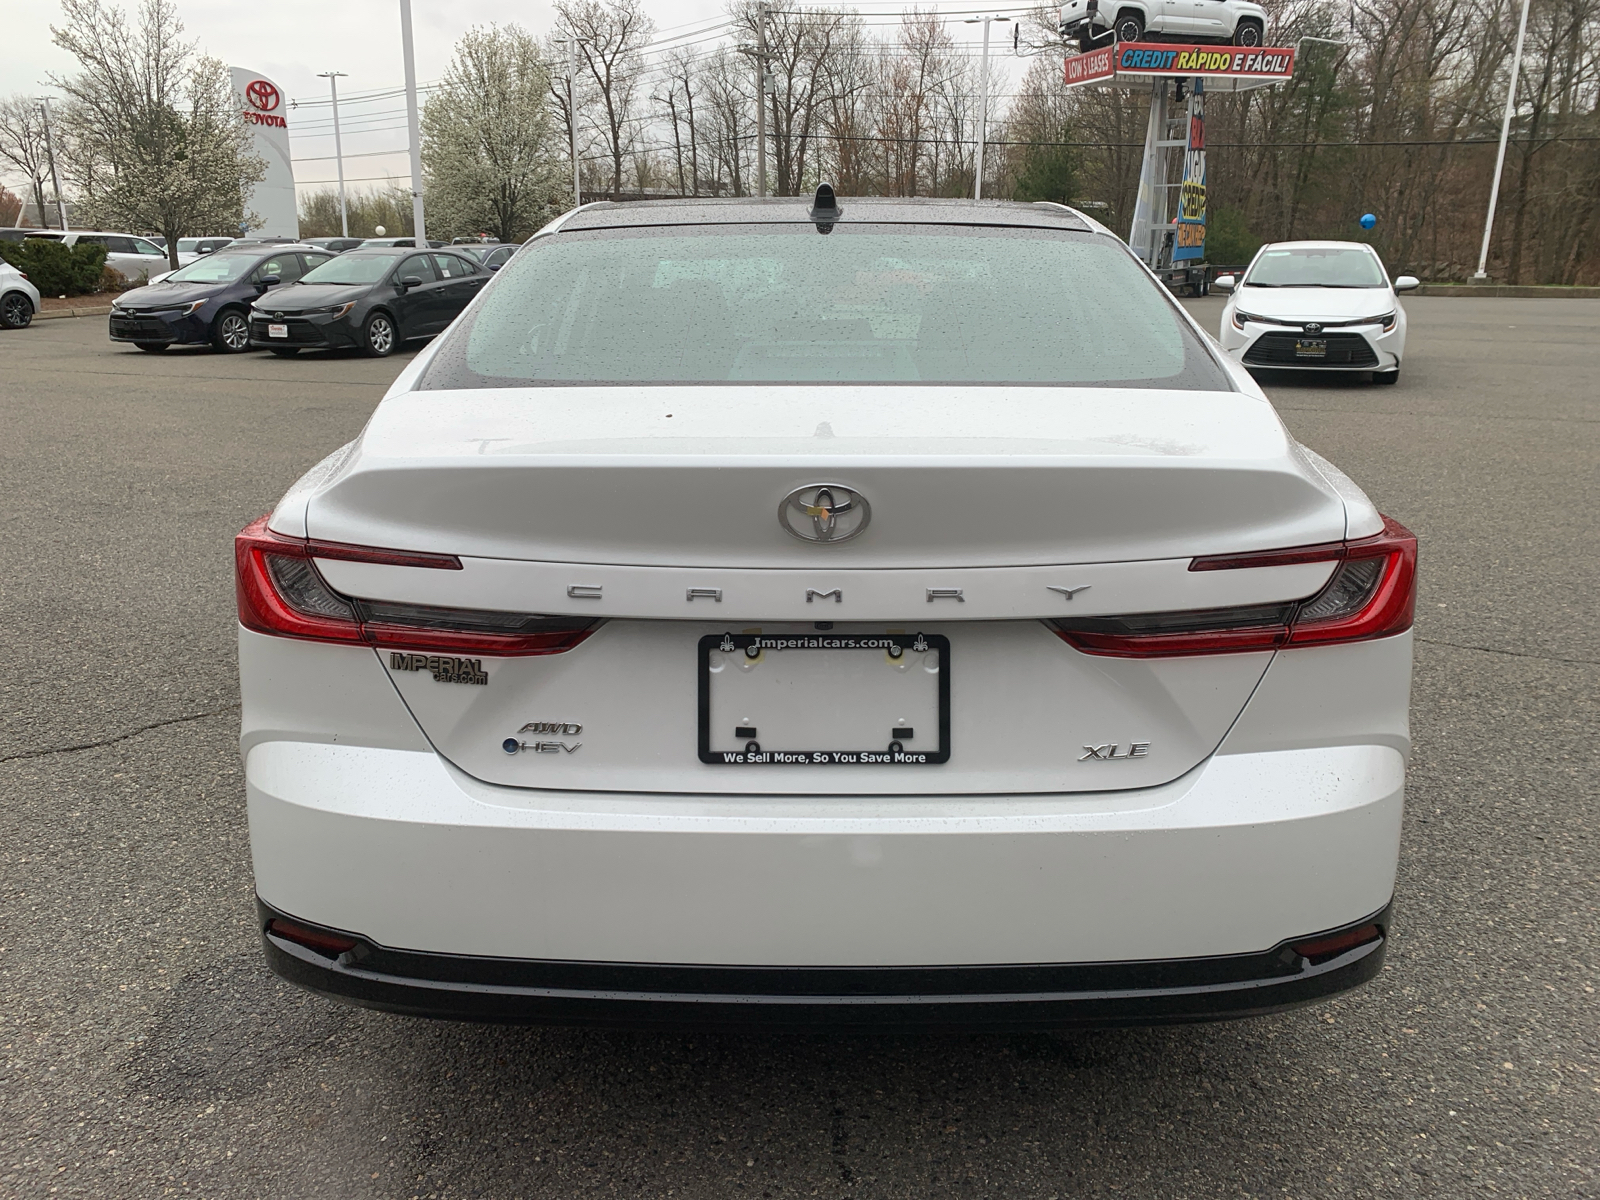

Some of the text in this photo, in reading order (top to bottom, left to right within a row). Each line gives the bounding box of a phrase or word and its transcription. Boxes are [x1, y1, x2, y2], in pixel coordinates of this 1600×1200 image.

[1068, 60, 1082, 79] LOW
[1088, 53, 1109, 74] LEASES
[1121, 48, 1290, 73] CREDIT RÁPIDO E FÁCIL!
[243, 111, 287, 129] TOYOTA
[566, 583, 1092, 603] CAMRY
[754, 637, 894, 650] Imperialcars.com
[389, 652, 488, 676] IMPERIAL
[433, 672, 488, 685] cars.com
[517, 721, 583, 735] AWD
[520, 741, 583, 754] HEV
[1077, 741, 1151, 762] XLE
[723, 752, 926, 765] We Sell More, So You Save More
